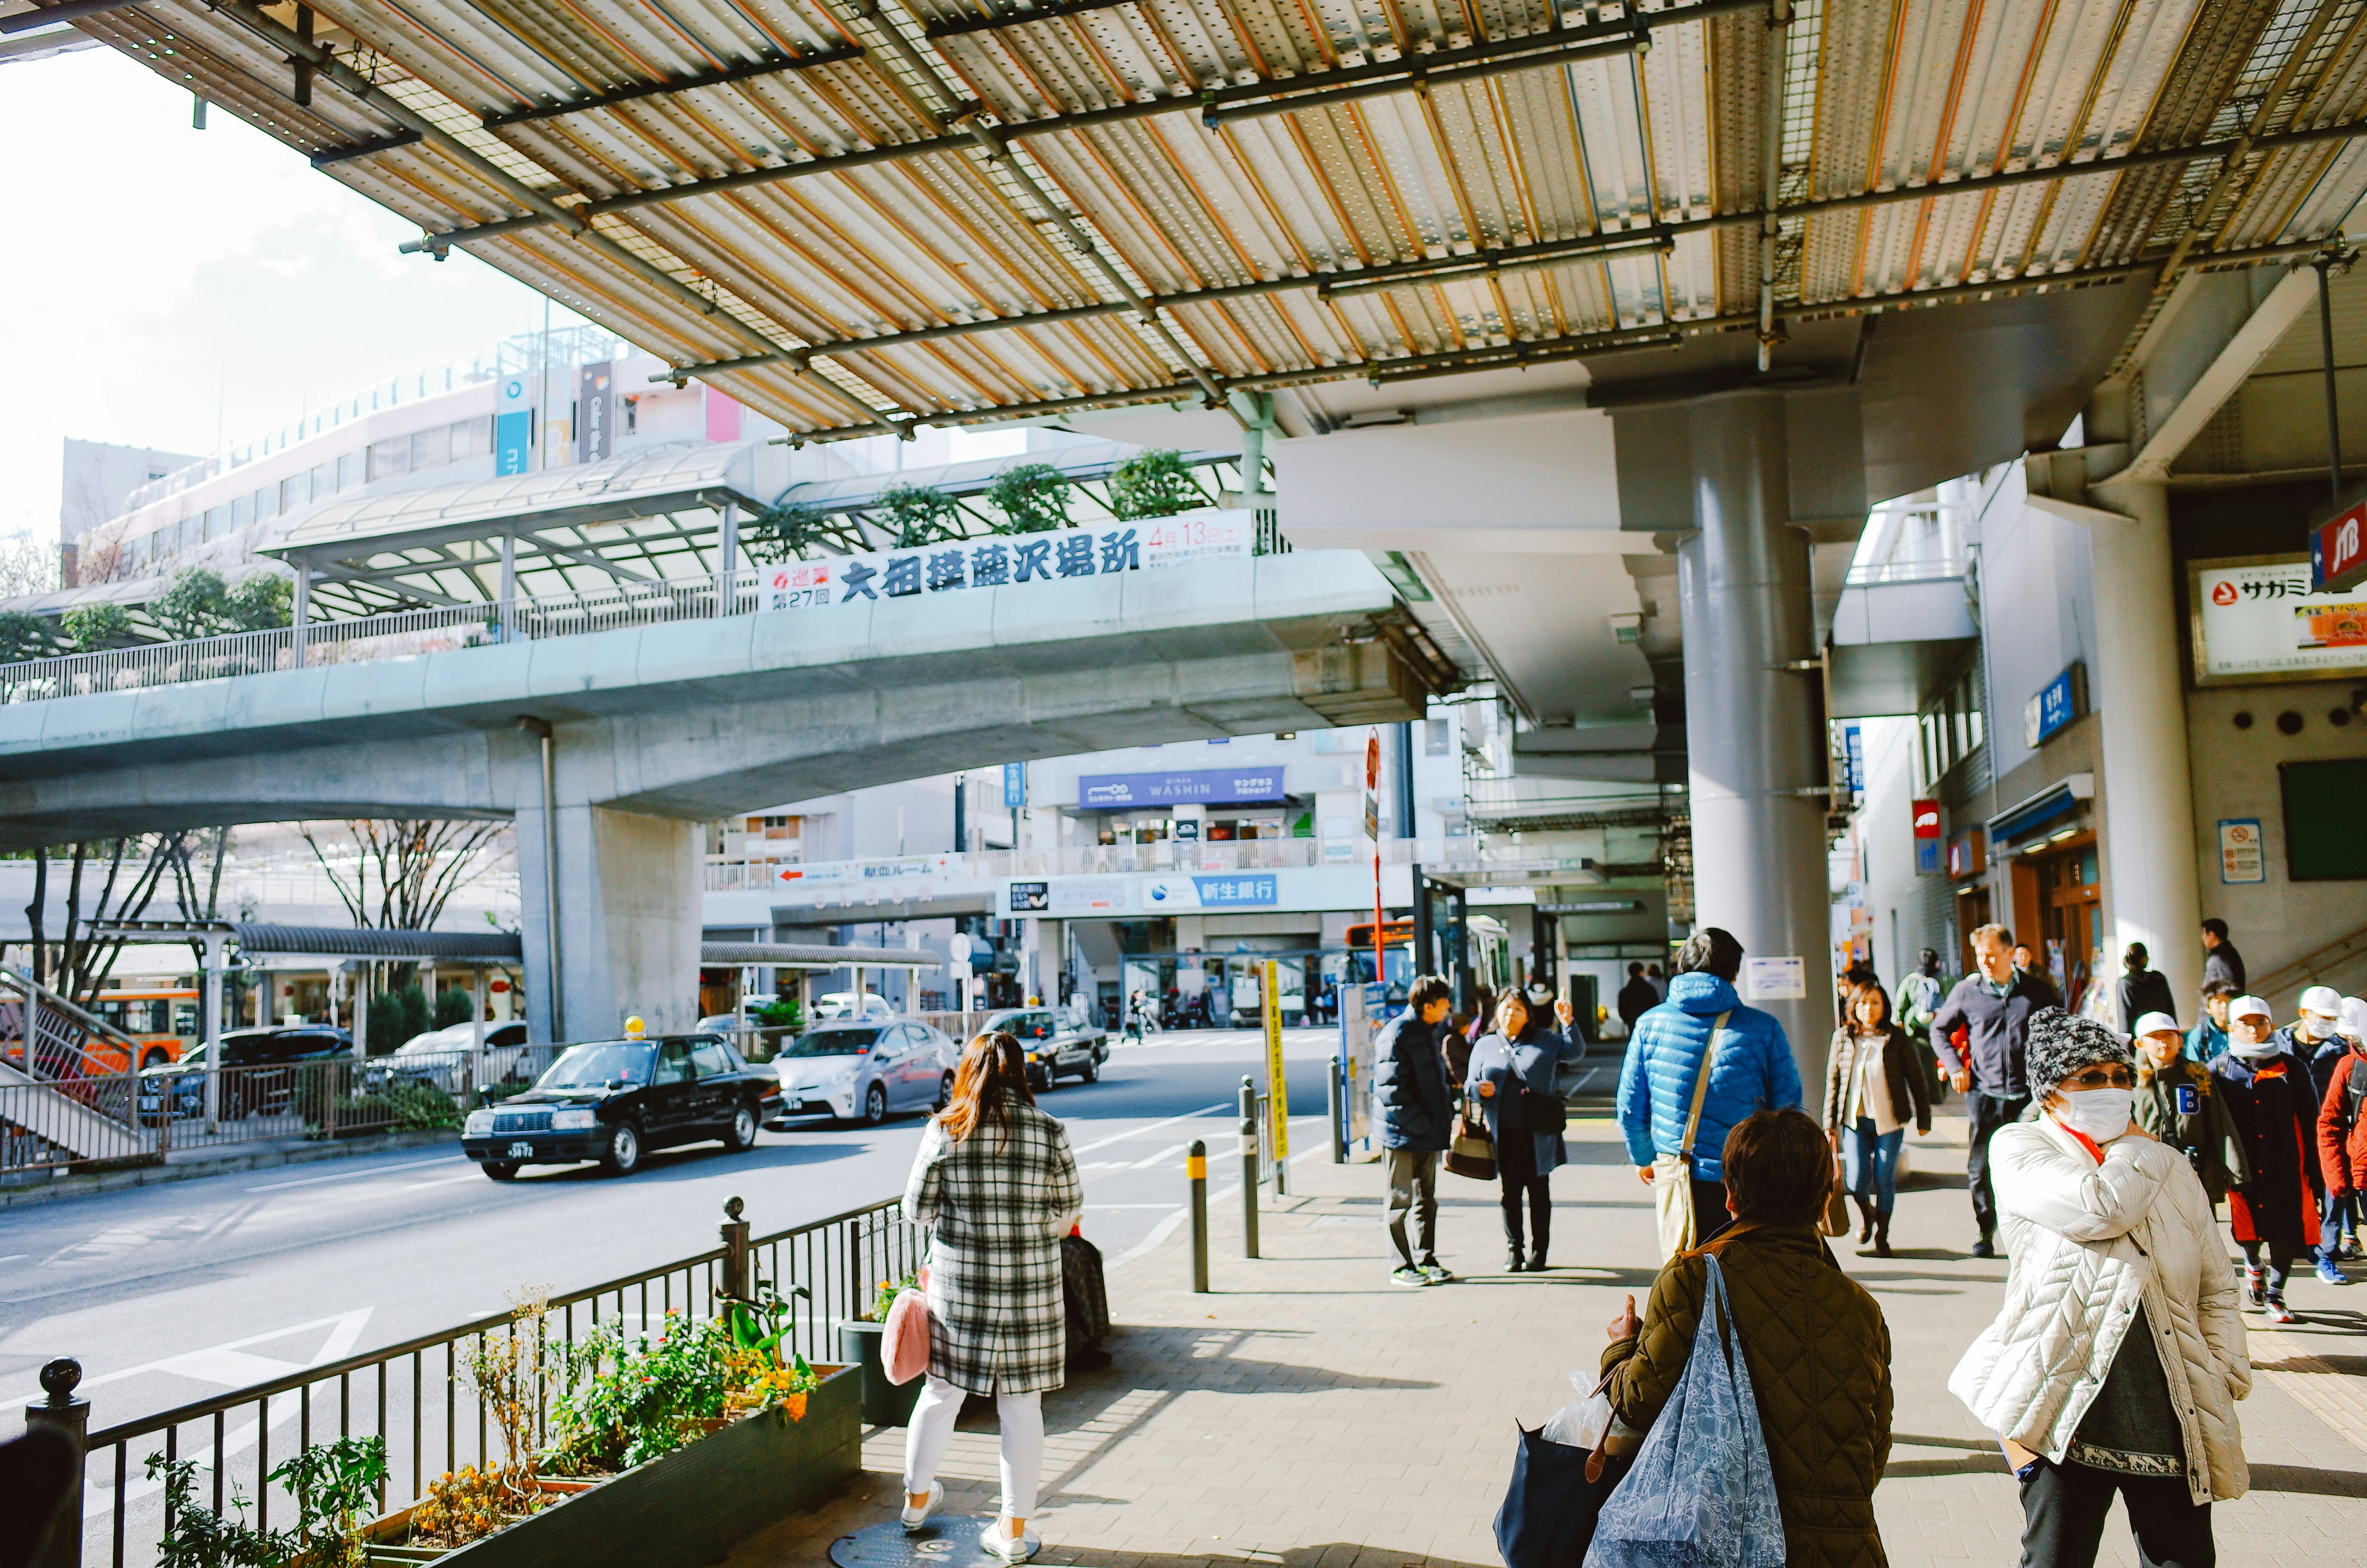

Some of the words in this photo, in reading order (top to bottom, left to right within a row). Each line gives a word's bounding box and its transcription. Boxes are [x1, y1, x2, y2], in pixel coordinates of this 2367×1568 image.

[841, 529, 1139, 603] 大相撲藤沢場所
[773, 567, 829, 589] 春巡業
[773, 589, 829, 610] 第27回
[1149, 784, 1210, 797] WASHIN
[864, 862, 933, 878] 献血ルーム
[1202, 880, 1273, 900] 新生銀行
[2176, 1084, 2200, 1115] B
